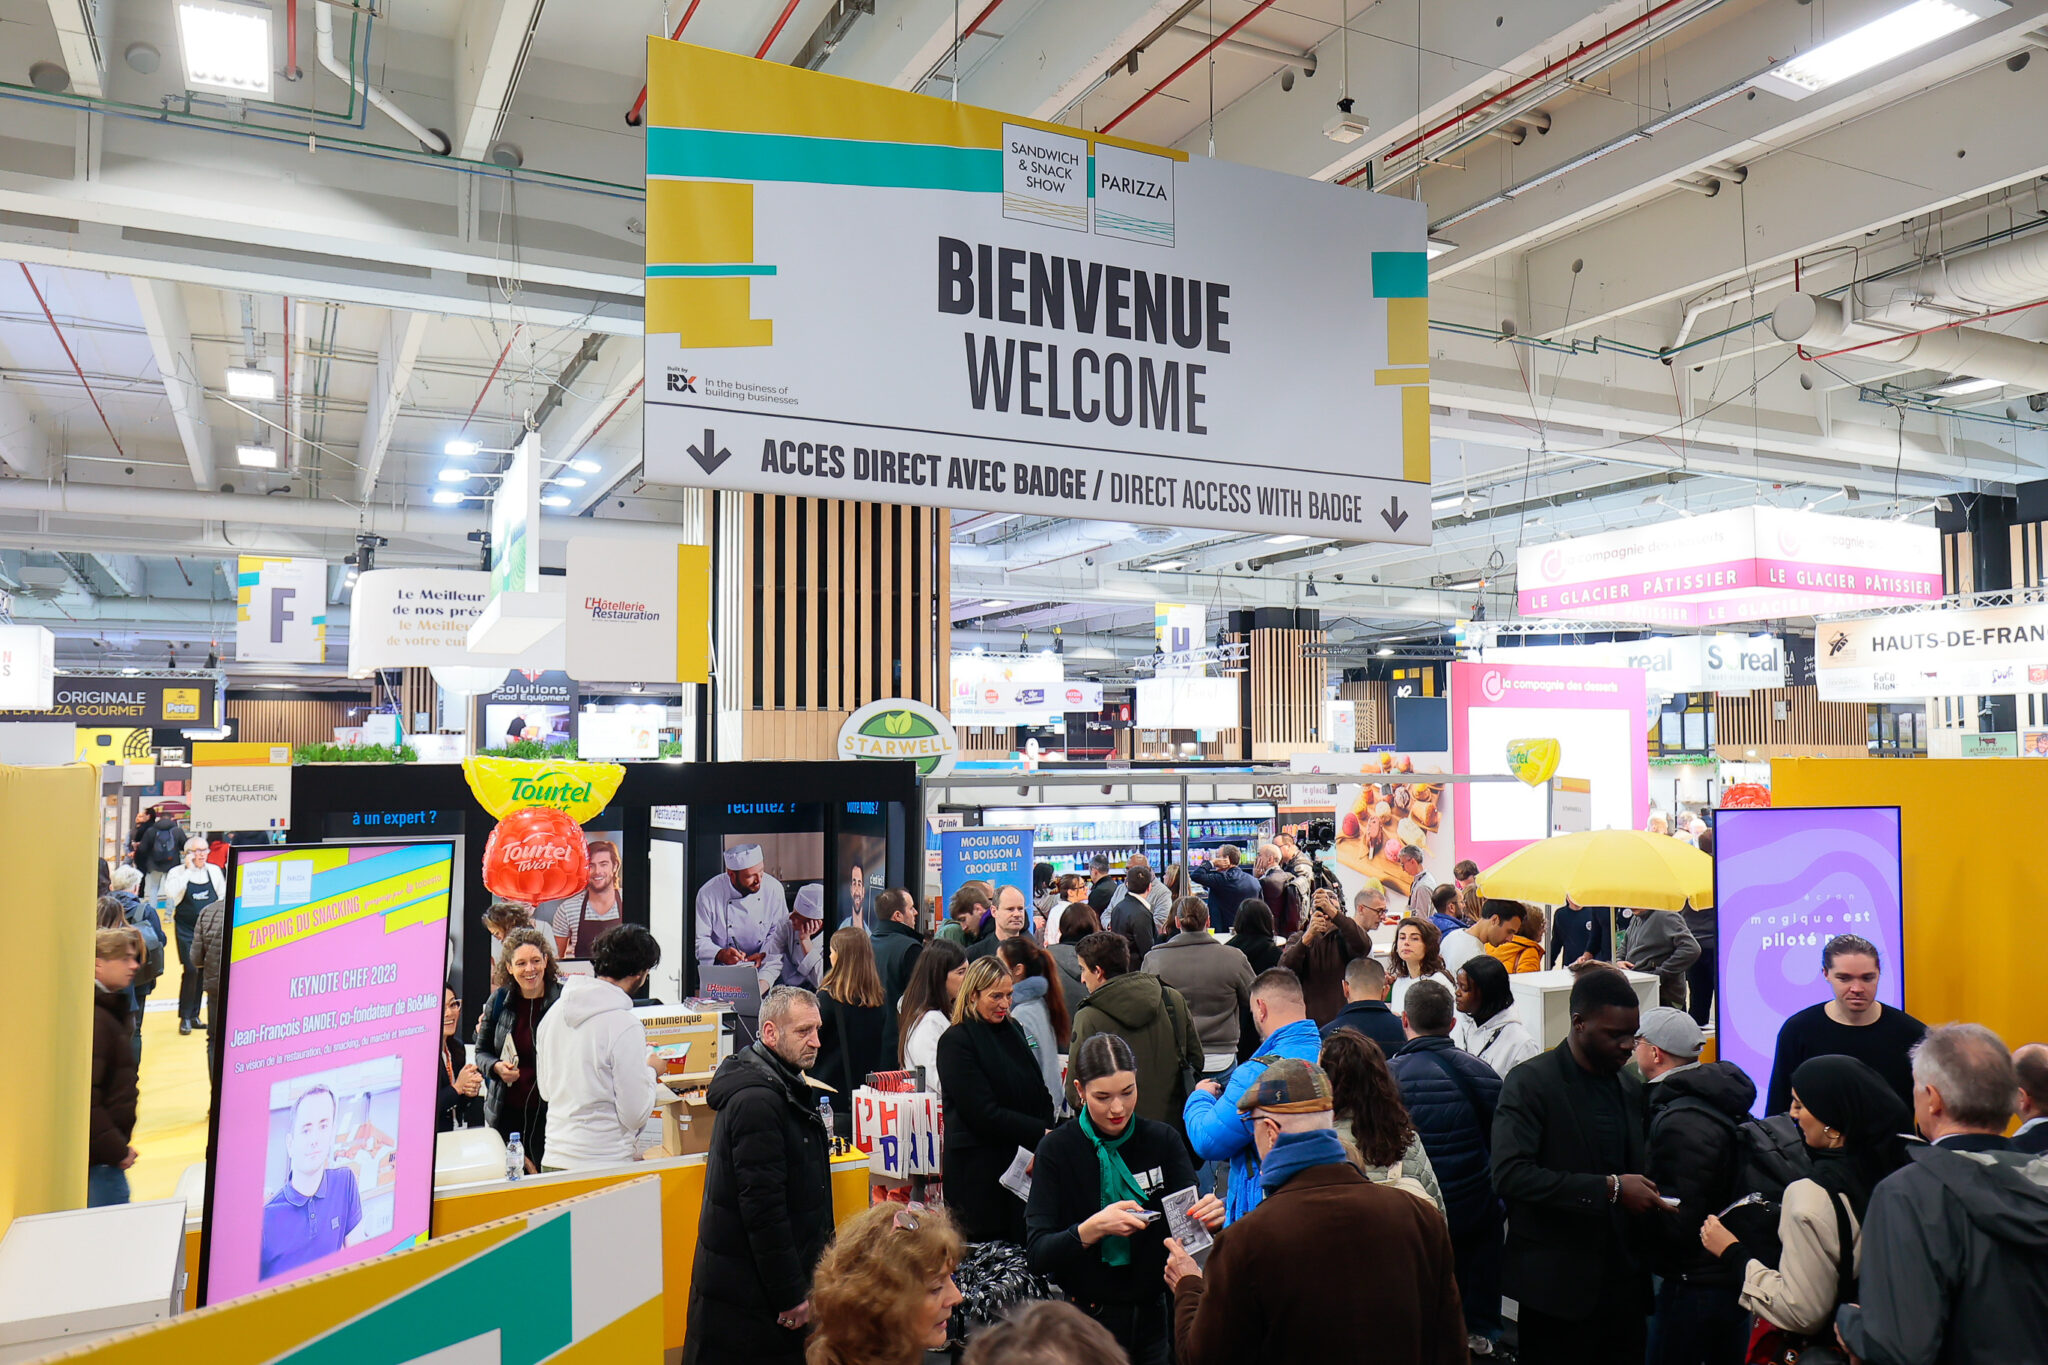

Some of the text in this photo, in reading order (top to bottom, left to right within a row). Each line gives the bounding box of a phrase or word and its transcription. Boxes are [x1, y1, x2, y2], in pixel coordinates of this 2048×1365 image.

[1011, 141, 1079, 166] SANDWICH
[1018, 159, 1072, 180] & SNACK
[1026, 175, 1065, 194] SHOW
[1101, 173, 1168, 201] PARIZZA
[938, 235, 1231, 354] BIENVENUE
[667, 373, 697, 393] RX
[705, 378, 714, 387] In
[717, 379, 733, 389] the
[735, 381, 777, 394] business
[965, 332, 1207, 435] WELCOME
[705, 387, 799, 405] building businesses
[761, 439, 1362, 523] ACCES DIRECT AVEC BADGE / DIRECT ACCESS WITH BADGE
[1532, 570, 1737, 609] LE GLACIER PÂTISSIER
[1769, 567, 1932, 595] LE GLACIER PÂTISSIER
[398, 589, 486, 602] Le Meilleur
[585, 597, 646, 612] L'Hôtellerie
[270, 588, 296, 643] F
[392, 605, 410, 615] de
[415, 607, 444, 615] nos
[592, 606, 660, 621] Restauration
[1708, 606, 1725, 620] LE
[399, 620, 412, 630] le
[386, 635, 400, 646] de
[404, 636, 441, 647] votre
[1872, 624, 2048, 652] HAUTS-DE-FRAN
[1172, 627, 1190, 669] U
[1708, 645, 1778, 671] Sreal
[496, 684, 568, 694] Solutions
[1513, 680, 1565, 692] compagnie
[1567, 680, 1582, 691] des
[56, 691, 147, 704] ORIGINALE
[520, 693, 571, 702] Equipment
[75, 705, 146, 716] GOURMET
[166, 702, 196, 714] Petra
[844, 735, 952, 755] STARWELL
[208, 783, 275, 792] L'HÔTELLERIE
[511, 776, 592, 803] Tourtel
[205, 794, 278, 803] RESTAURATION
[195, 821, 212, 829] F10
[364, 814, 380, 825] un
[383, 811, 426, 828] expert
[429, 810, 437, 824] ?
[938, 820, 958, 828] Drink
[501, 835, 573, 863] Tourtel
[961, 835, 1020, 847] MOGU MOGU
[959, 848, 1022, 861] LA BOISSON A
[514, 859, 555, 872] Twist
[965, 862, 1008, 874] CROQUER
[249, 921, 294, 949] ZAPPING
[297, 912, 310, 931] DU
[313, 896, 360, 927] SNACKING
[1750, 911, 1870, 926] magique est
[1762, 932, 1817, 950] piloté
[290, 963, 398, 999] KEYNOTE CHEF 2023
[230, 992, 438, 1048] Jean-François BANDET, co-fondateur de Bo&Mie
[234, 1062, 245, 1074] Sa
[245, 1058, 265, 1071] vision
[266, 1056, 275, 1066] de
[276, 1054, 283, 1064] la
[284, 1047, 323, 1062] restauration,
[323, 1044, 332, 1054] du
